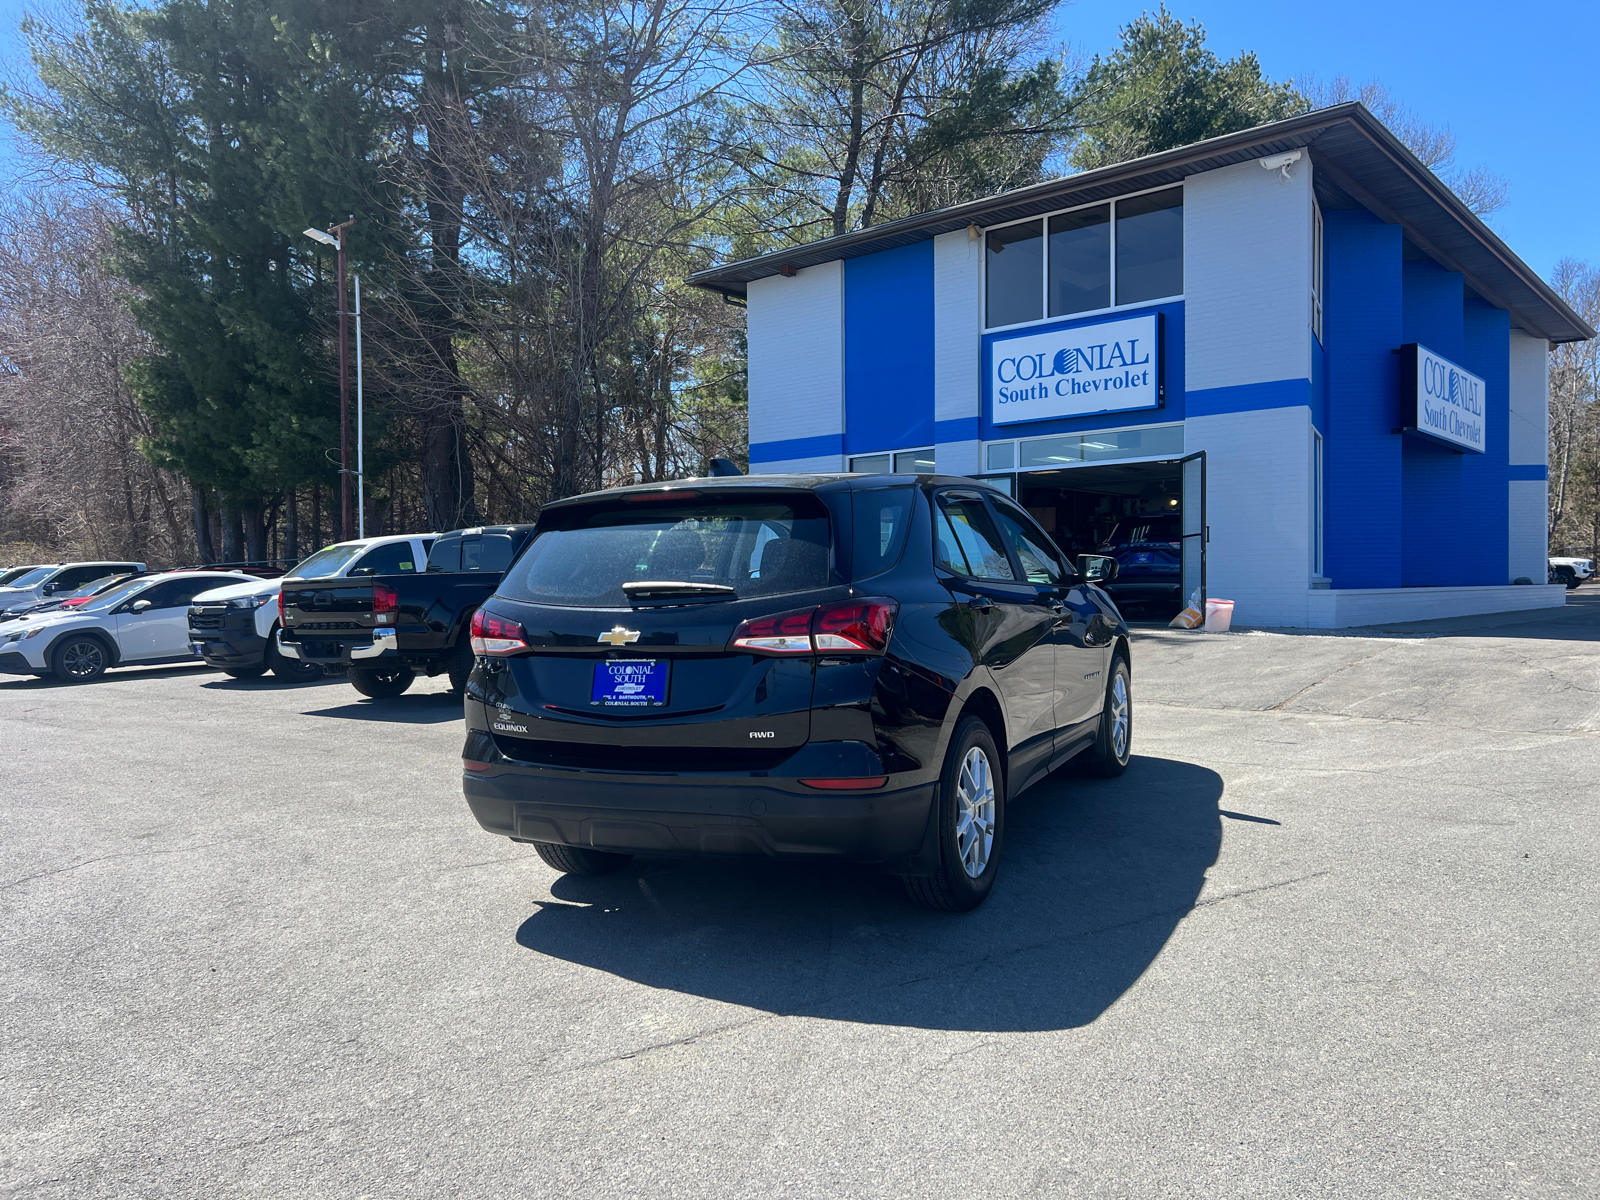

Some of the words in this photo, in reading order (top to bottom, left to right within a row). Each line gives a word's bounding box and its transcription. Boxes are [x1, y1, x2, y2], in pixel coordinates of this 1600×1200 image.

[997, 339, 1149, 384] COLONIAL
[998, 383, 1049, 404] South
[1055, 369, 1149, 396] Chevrolet
[1424, 356, 1481, 417] COLONIAL
[1424, 399, 1447, 432] South
[1449, 410, 1482, 444] Chevrolet
[608, 666, 653, 675] COLONIAL
[614, 674, 646, 683] SOUTH
[493, 722, 529, 733] EQUINOX
[749, 731, 775, 739] AWD
